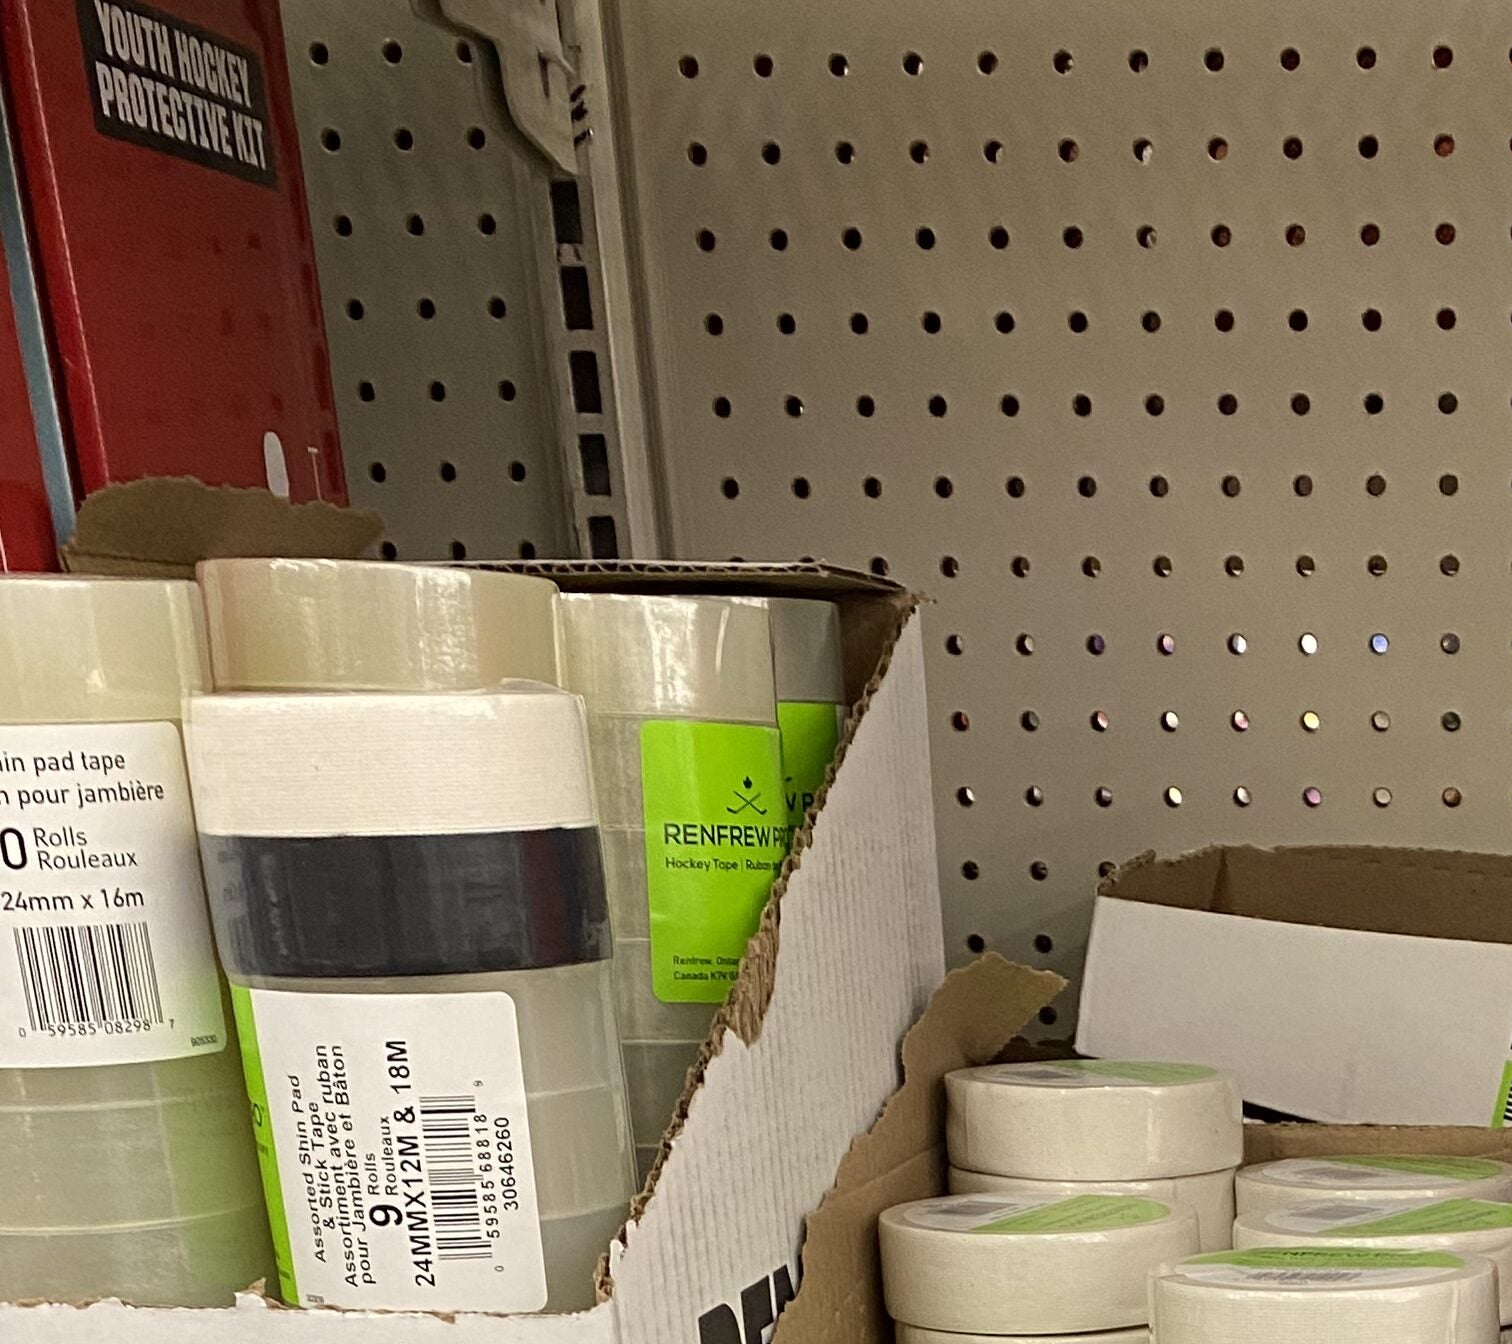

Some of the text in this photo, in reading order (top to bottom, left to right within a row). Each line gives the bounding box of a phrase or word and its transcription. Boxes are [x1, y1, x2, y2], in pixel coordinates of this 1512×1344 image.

[94, 0, 251, 108] YOUTH HOCKEY
[95, 61, 266, 170] PROTECTIVE KIT
[34, 751, 125, 776] pad tape
[18, 788, 69, 809] pour
[77, 779, 165, 808] jambière
[33, 826, 87, 848] Rolls
[37, 849, 138, 870] Rouleaux
[664, 823, 771, 847] RENFREW
[665, 858, 709, 872] Hockey
[714, 859, 738, 870] Tape
[1, 890, 74, 911] 24mm
[101, 887, 144, 908] 16m
[309, 1102, 325, 1152] Tape
[380, 1116, 398, 1196] Rouleaux
[288, 1075, 326, 1262] Assorted Shin Pad
[315, 1045, 358, 1287] Assortiment avec ruban
[316, 1160, 332, 1207] Stick
[332, 1046, 376, 1284] pour Jambière et Bâton
[364, 1153, 402, 1227] 9 Rolls
[385, 1041, 436, 1287] 24MMX12M & 18M
[493, 1117, 519, 1211] 30646260
[481, 1180, 500, 1239] 59585
